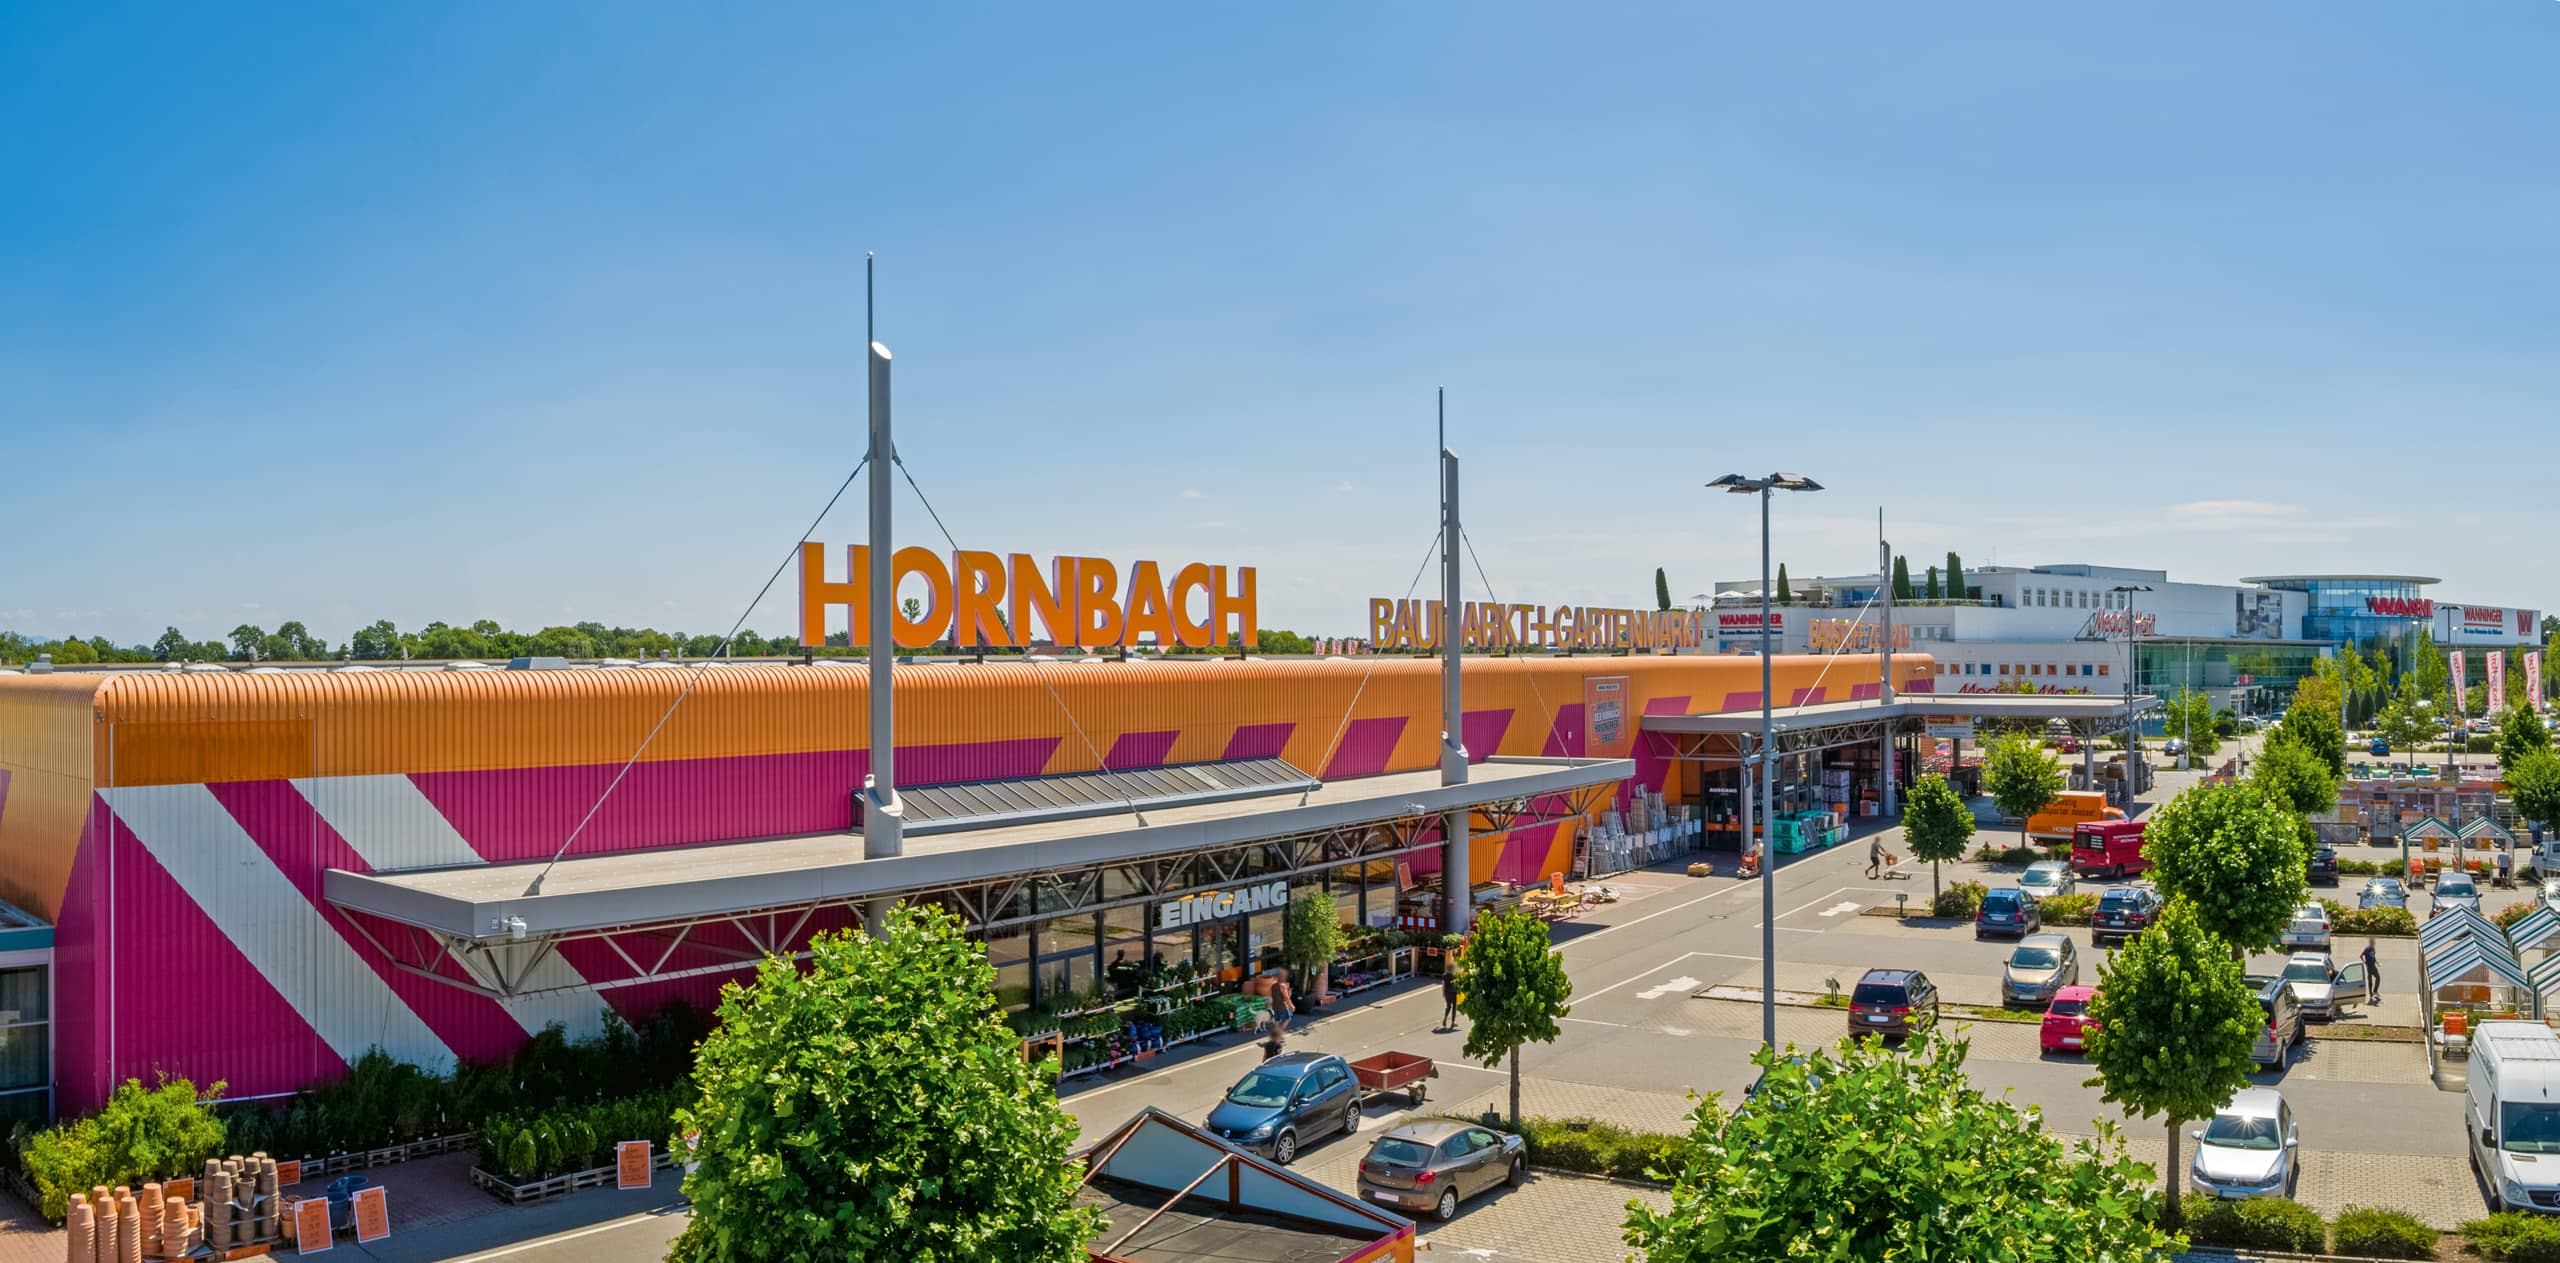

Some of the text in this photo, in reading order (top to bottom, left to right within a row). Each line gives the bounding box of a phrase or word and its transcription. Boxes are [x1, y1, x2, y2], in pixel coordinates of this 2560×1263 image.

[800, 541, 1257, 648] HORNBACH
[1719, 613, 1782, 625] WANNINER
[1369, 598, 1705, 649] BAUARKT+GARTENMARKT
[1161, 881, 1287, 929] EINGANG
